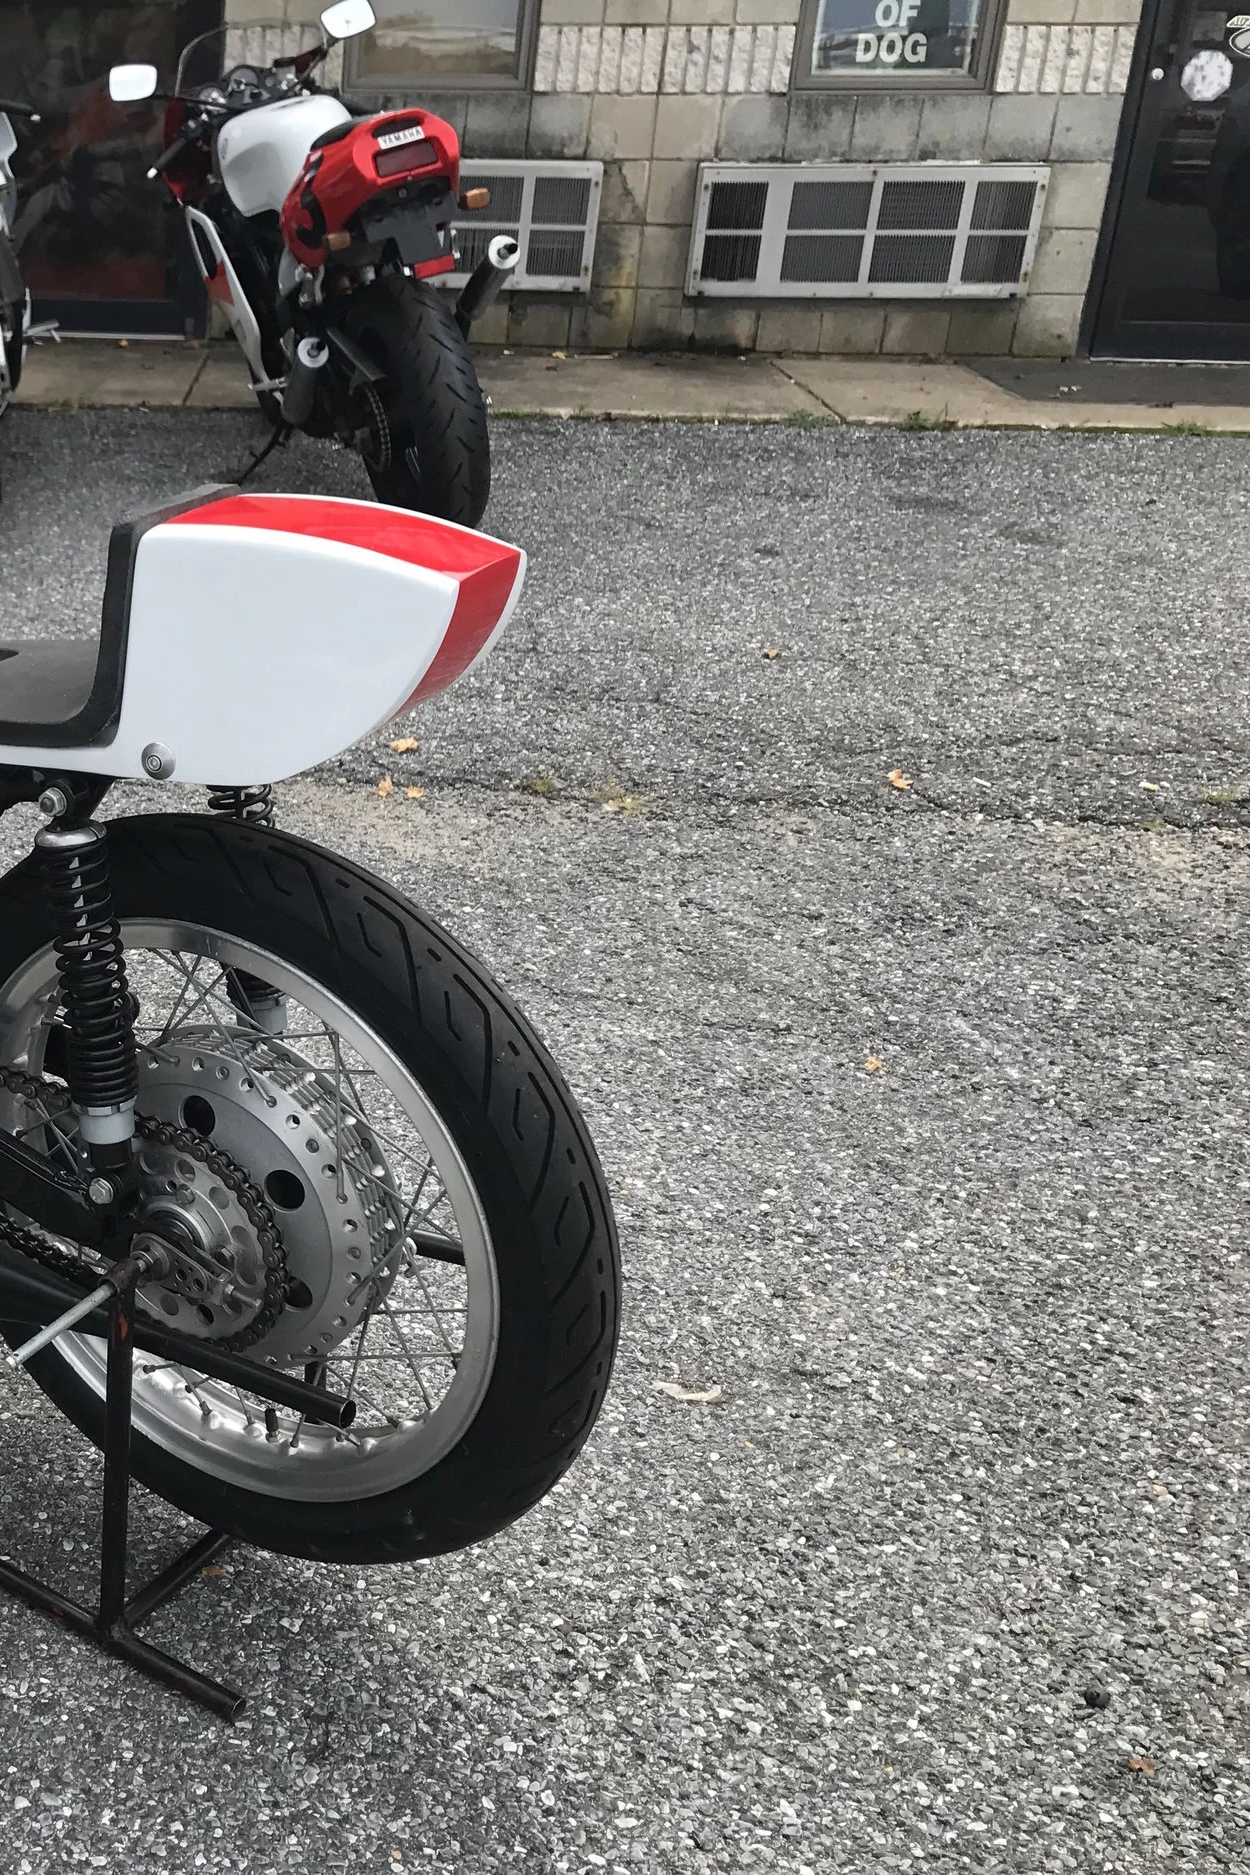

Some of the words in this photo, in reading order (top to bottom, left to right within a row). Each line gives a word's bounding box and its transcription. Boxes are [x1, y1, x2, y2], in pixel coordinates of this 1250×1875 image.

[875, 0, 921, 27] OF
[856, 32, 927, 63] DOG
[380, 127, 422, 146] YAMAHA
